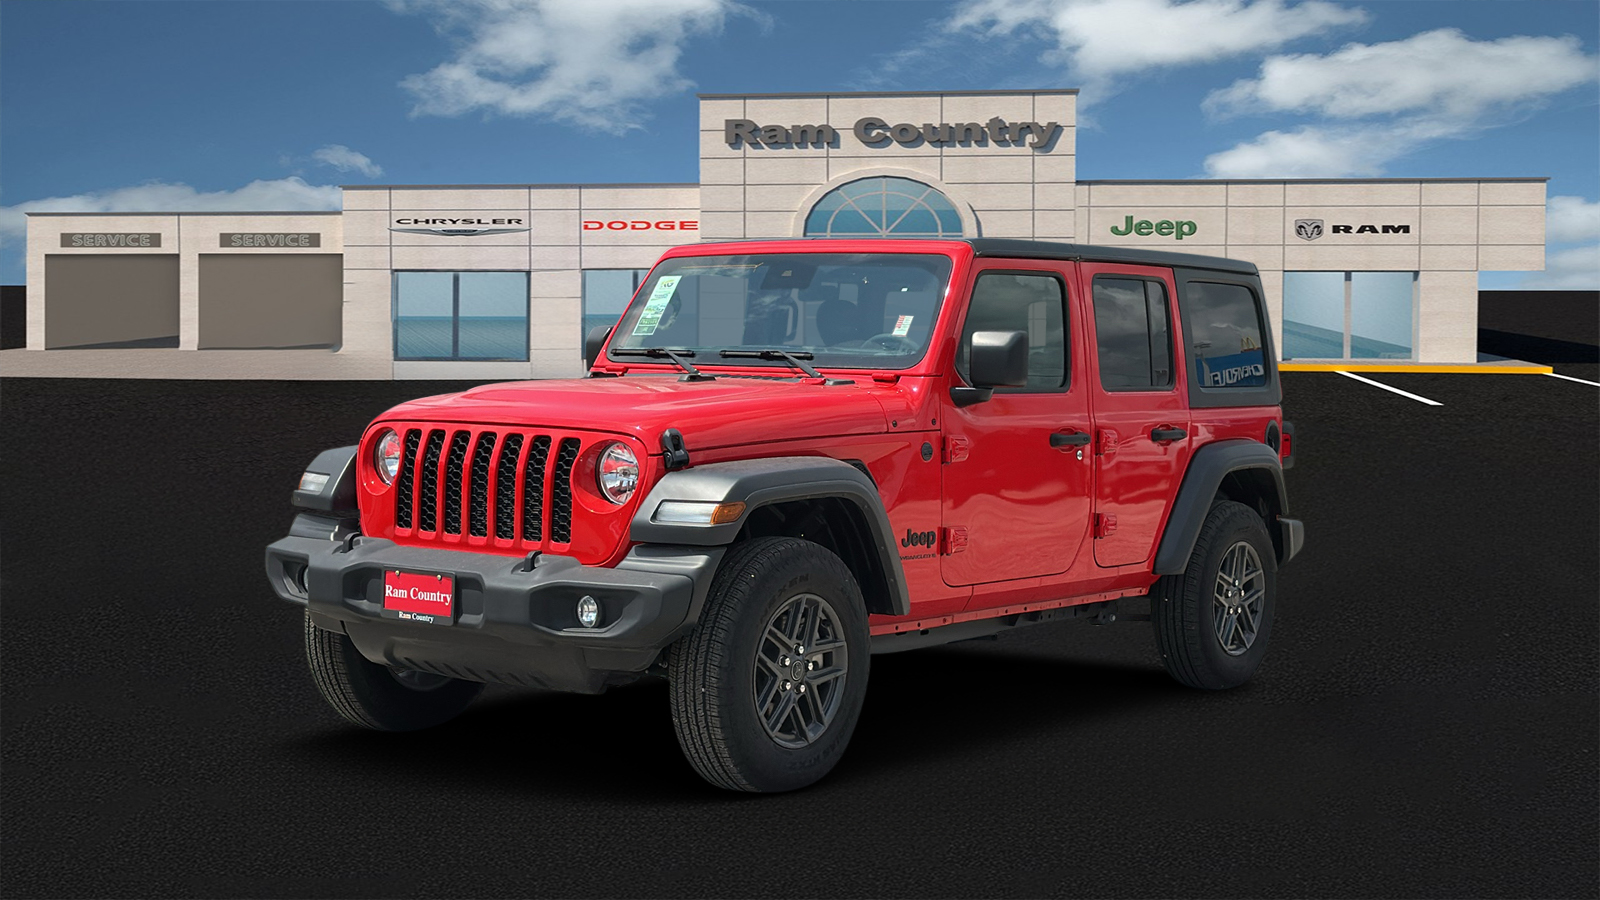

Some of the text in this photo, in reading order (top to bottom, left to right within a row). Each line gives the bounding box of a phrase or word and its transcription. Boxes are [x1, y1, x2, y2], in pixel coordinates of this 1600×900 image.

[724, 116, 1058, 148] Ram Country
[583, 220, 699, 230] DODGE
[1110, 215, 1198, 240] Jeep
[1331, 225, 1411, 234] RAM
[72, 234, 151, 247] SERVICE
[230, 234, 310, 247] SERVICE
[901, 528, 937, 549] Jeep
[385, 584, 452, 606] Ram Country
[399, 611, 435, 624] Ram Country
